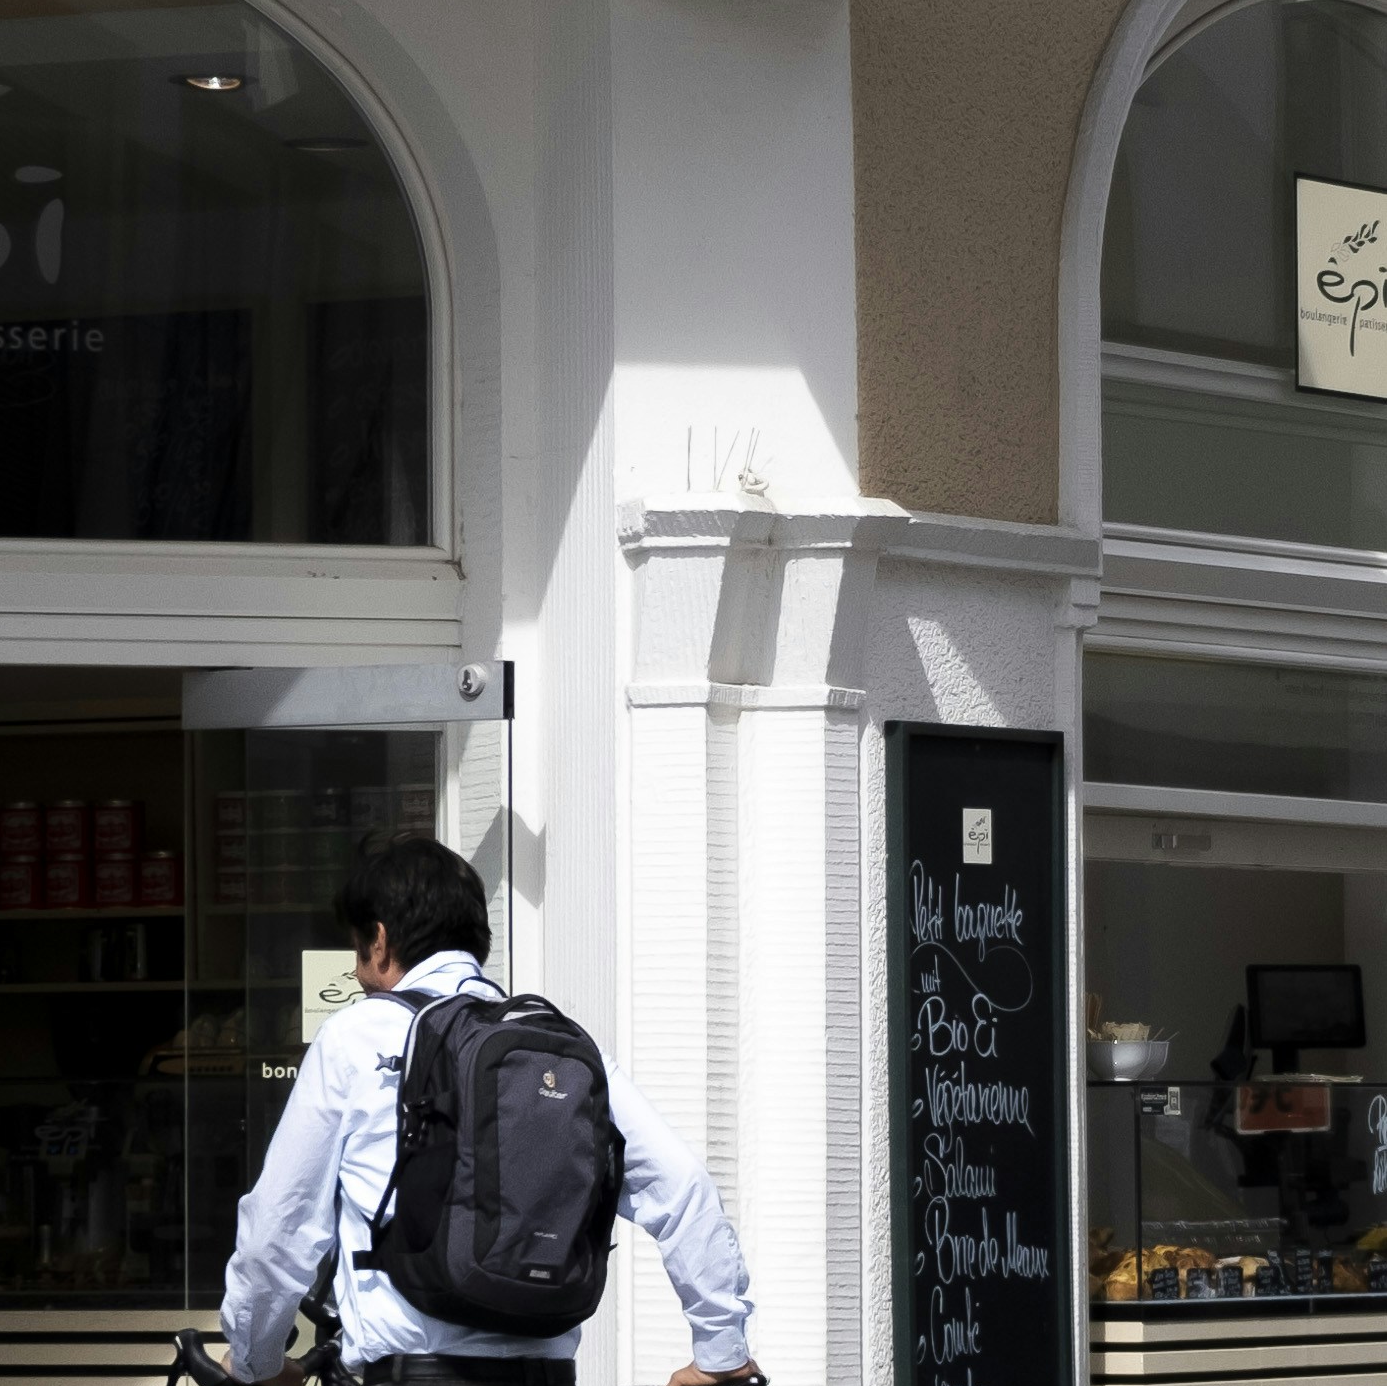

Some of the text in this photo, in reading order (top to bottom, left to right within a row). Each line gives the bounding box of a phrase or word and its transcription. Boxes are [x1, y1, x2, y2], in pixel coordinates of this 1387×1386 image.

[1300, 308, 1348, 326] boulangerie
[909, 860, 1025, 962] Petit baguette
[920, 954, 942, 994] mit
[918, 993, 999, 1058] Bio Ei
[262, 1062, 298, 1079] bon
[925, 1133, 997, 1199] Salami
[925, 1196, 1050, 1284] Brie de Meaux
